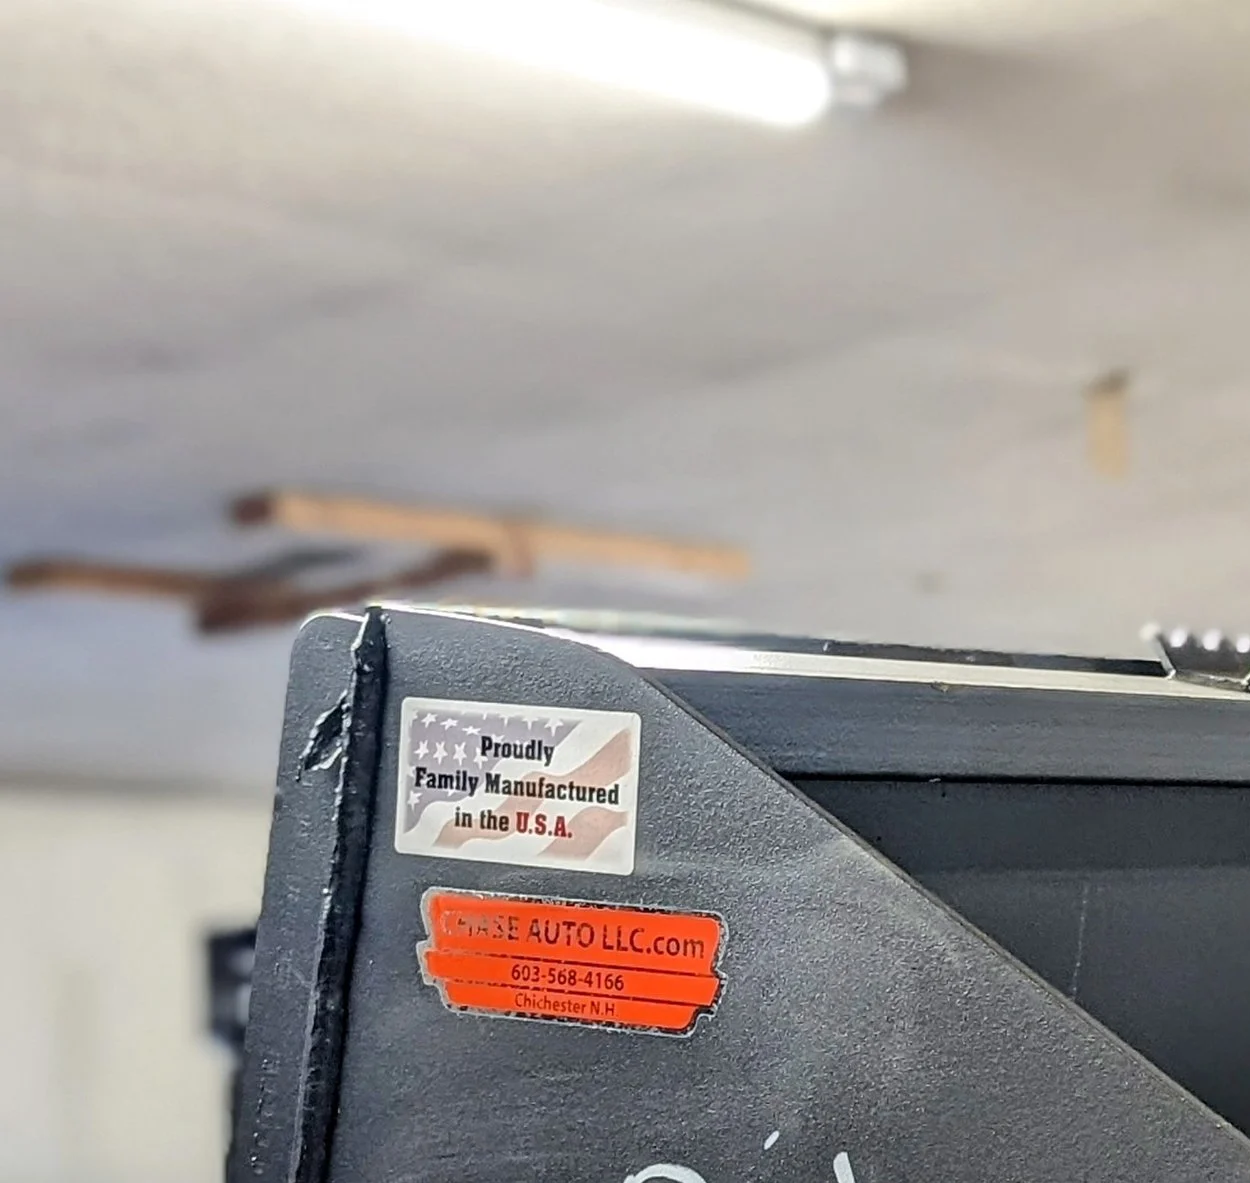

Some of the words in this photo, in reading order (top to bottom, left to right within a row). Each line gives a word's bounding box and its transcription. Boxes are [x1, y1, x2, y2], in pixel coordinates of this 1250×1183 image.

[480, 735, 555, 767] Proudly
[414, 766, 479, 797] Family
[484, 772, 620, 806] Manufactured
[454, 806, 472, 829] in
[479, 808, 510, 832] the
[515, 811, 573, 839] U.S.A.
[526, 917, 596, 949] AUTO
[602, 924, 706, 959] LLC.com
[511, 963, 625, 991] 603-568-4166
[514, 992, 586, 1015] Chichester
